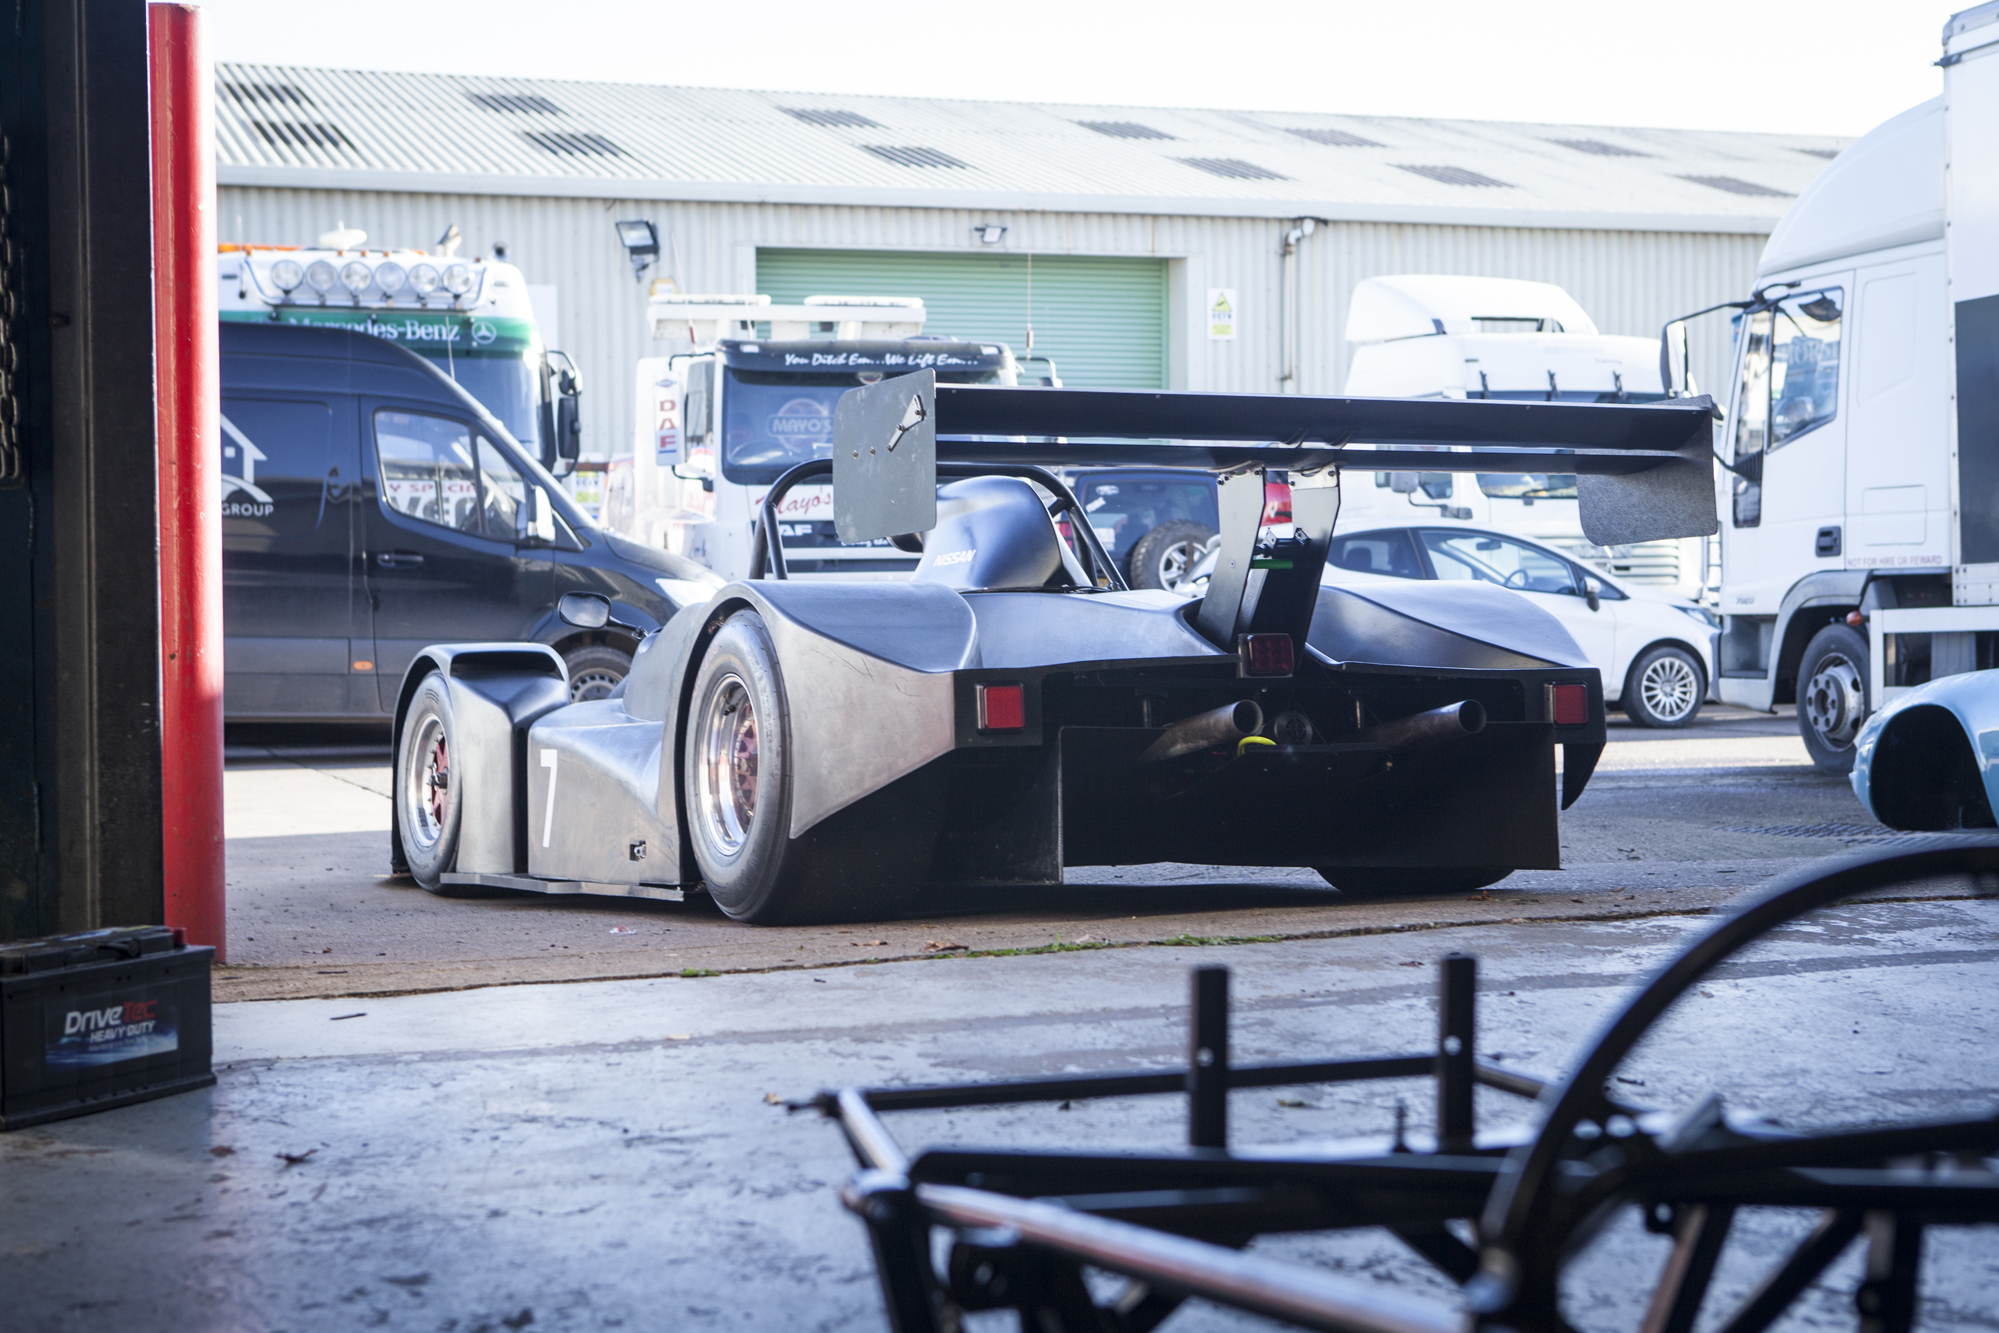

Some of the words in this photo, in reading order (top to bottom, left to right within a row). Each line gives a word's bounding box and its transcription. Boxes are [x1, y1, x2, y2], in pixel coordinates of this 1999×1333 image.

[288, 317, 460, 341] des-Benz
[785, 353, 810, 366] You
[812, 353, 847, 367] Ditch
[908, 353, 935, 368] Lift
[659, 400, 677, 449] DAF
[222, 502, 274, 517] GROUP
[779, 524, 813, 536] AF
[932, 549, 977, 567] NISSAN
[1848, 557, 1861, 567] NOT
[1863, 557, 1877, 567] FOR
[1879, 556, 1895, 566] HIRE
[1897, 556, 1908, 565] OR
[1910, 554, 1943, 565] REWARD
[540, 748, 558, 848] 7
[89, 1026, 127, 1043] HEAVY
[126, 1020, 156, 1036] DUTY
